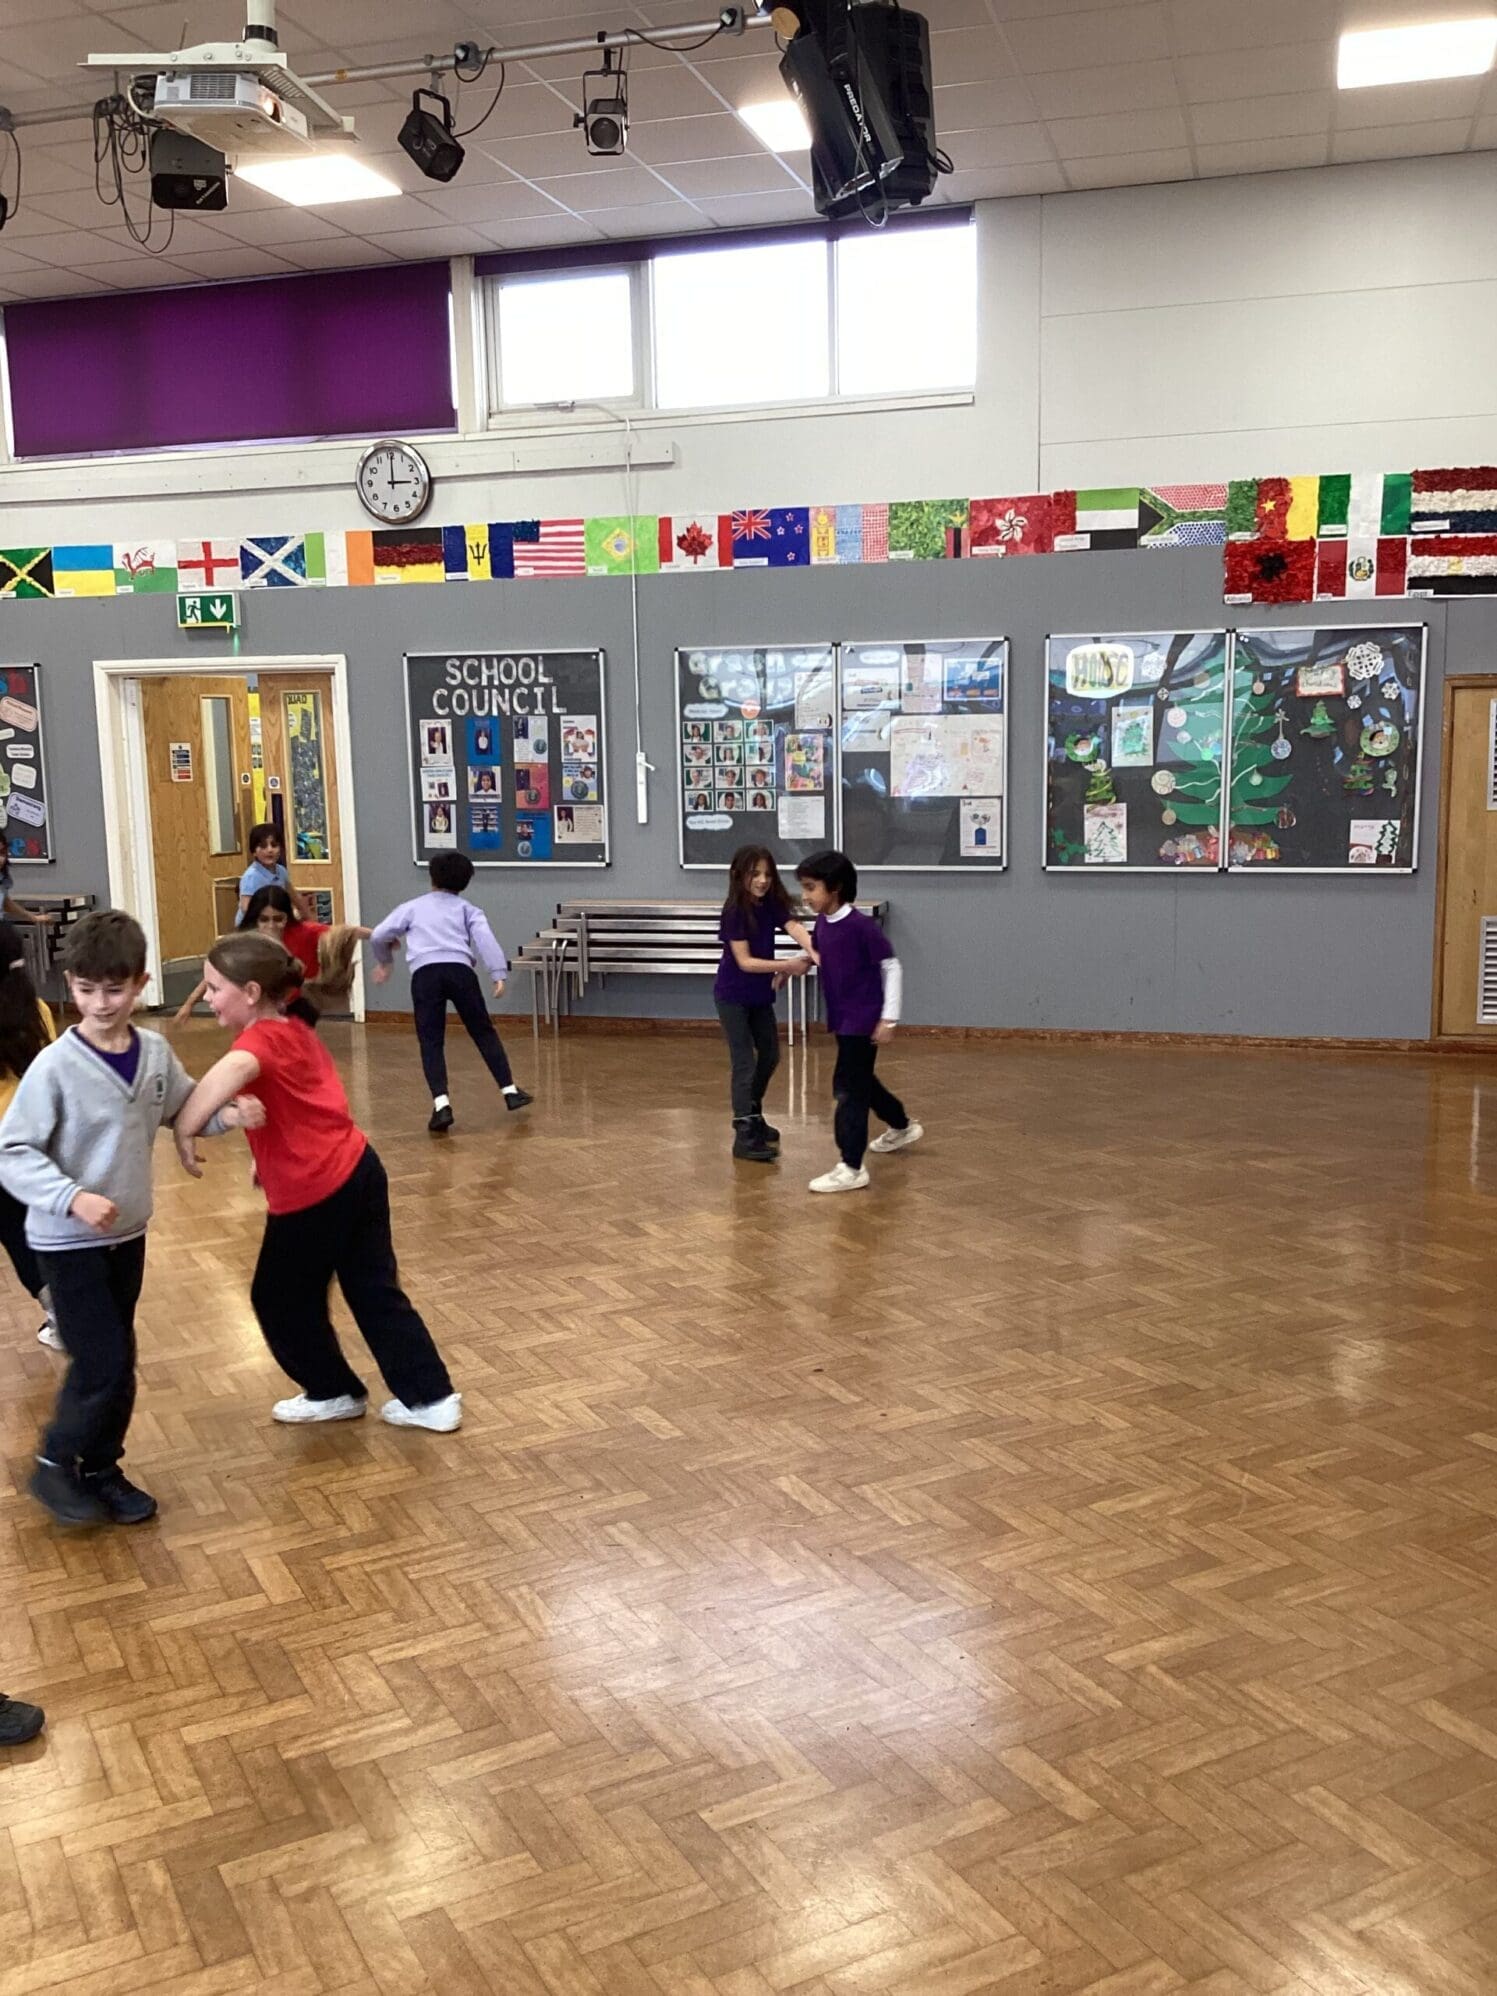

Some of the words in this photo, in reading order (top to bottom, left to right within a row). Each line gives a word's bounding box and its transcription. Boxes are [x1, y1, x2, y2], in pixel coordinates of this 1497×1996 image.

[843, 83, 872, 143] PREDATOR
[376, 456, 383, 464] 11
[408, 464, 414, 472] 2
[367, 479, 373, 487] 9
[413, 477, 420, 485] 3
[372, 493, 379, 501] 8
[382, 502, 388, 510] 7
[393, 504, 400, 512] 6
[445, 656, 553, 686] SCHOOL
[432, 686, 567, 716] COUNCIL
